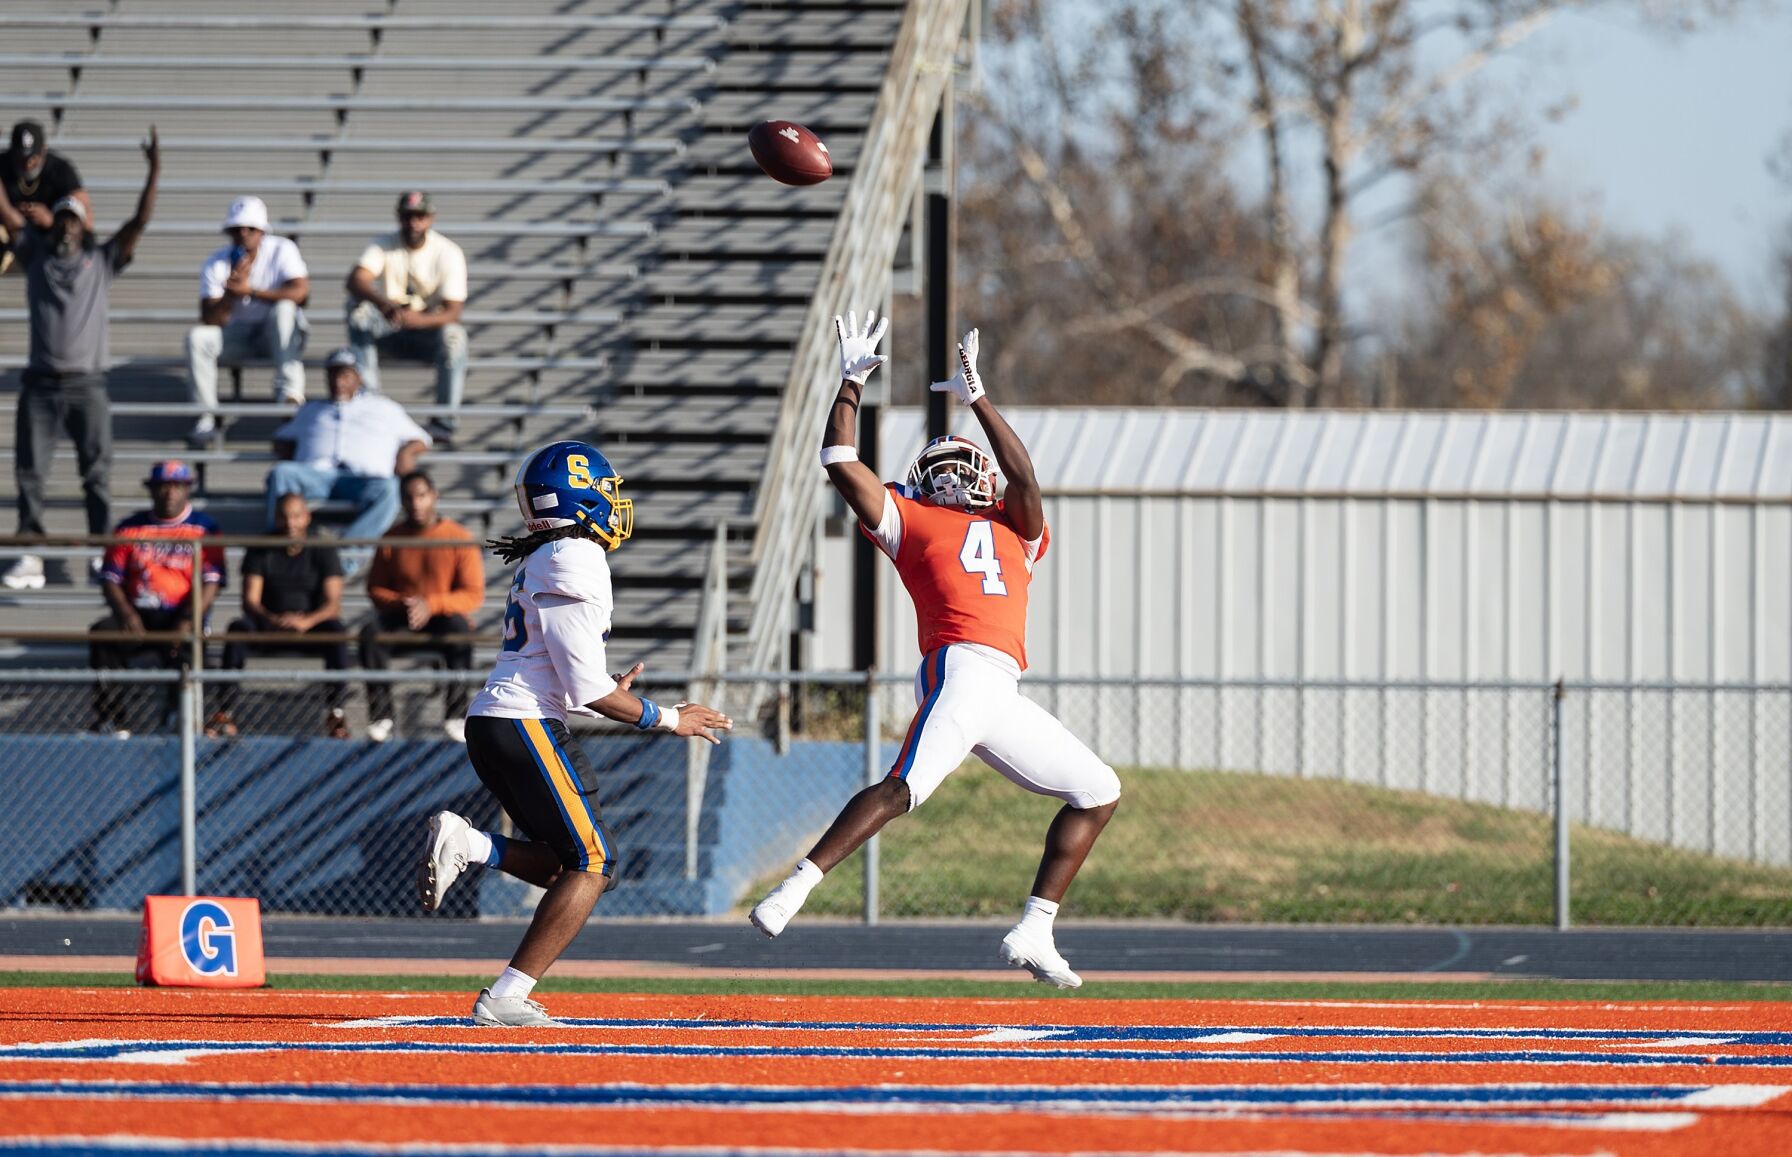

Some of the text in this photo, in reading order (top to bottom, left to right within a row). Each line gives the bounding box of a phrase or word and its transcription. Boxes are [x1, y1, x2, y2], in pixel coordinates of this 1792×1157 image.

[959, 348, 977, 394] GEORGIA
[566, 454, 592, 489] S
[959, 520, 1008, 596] 4
[179, 899, 238, 977] G
